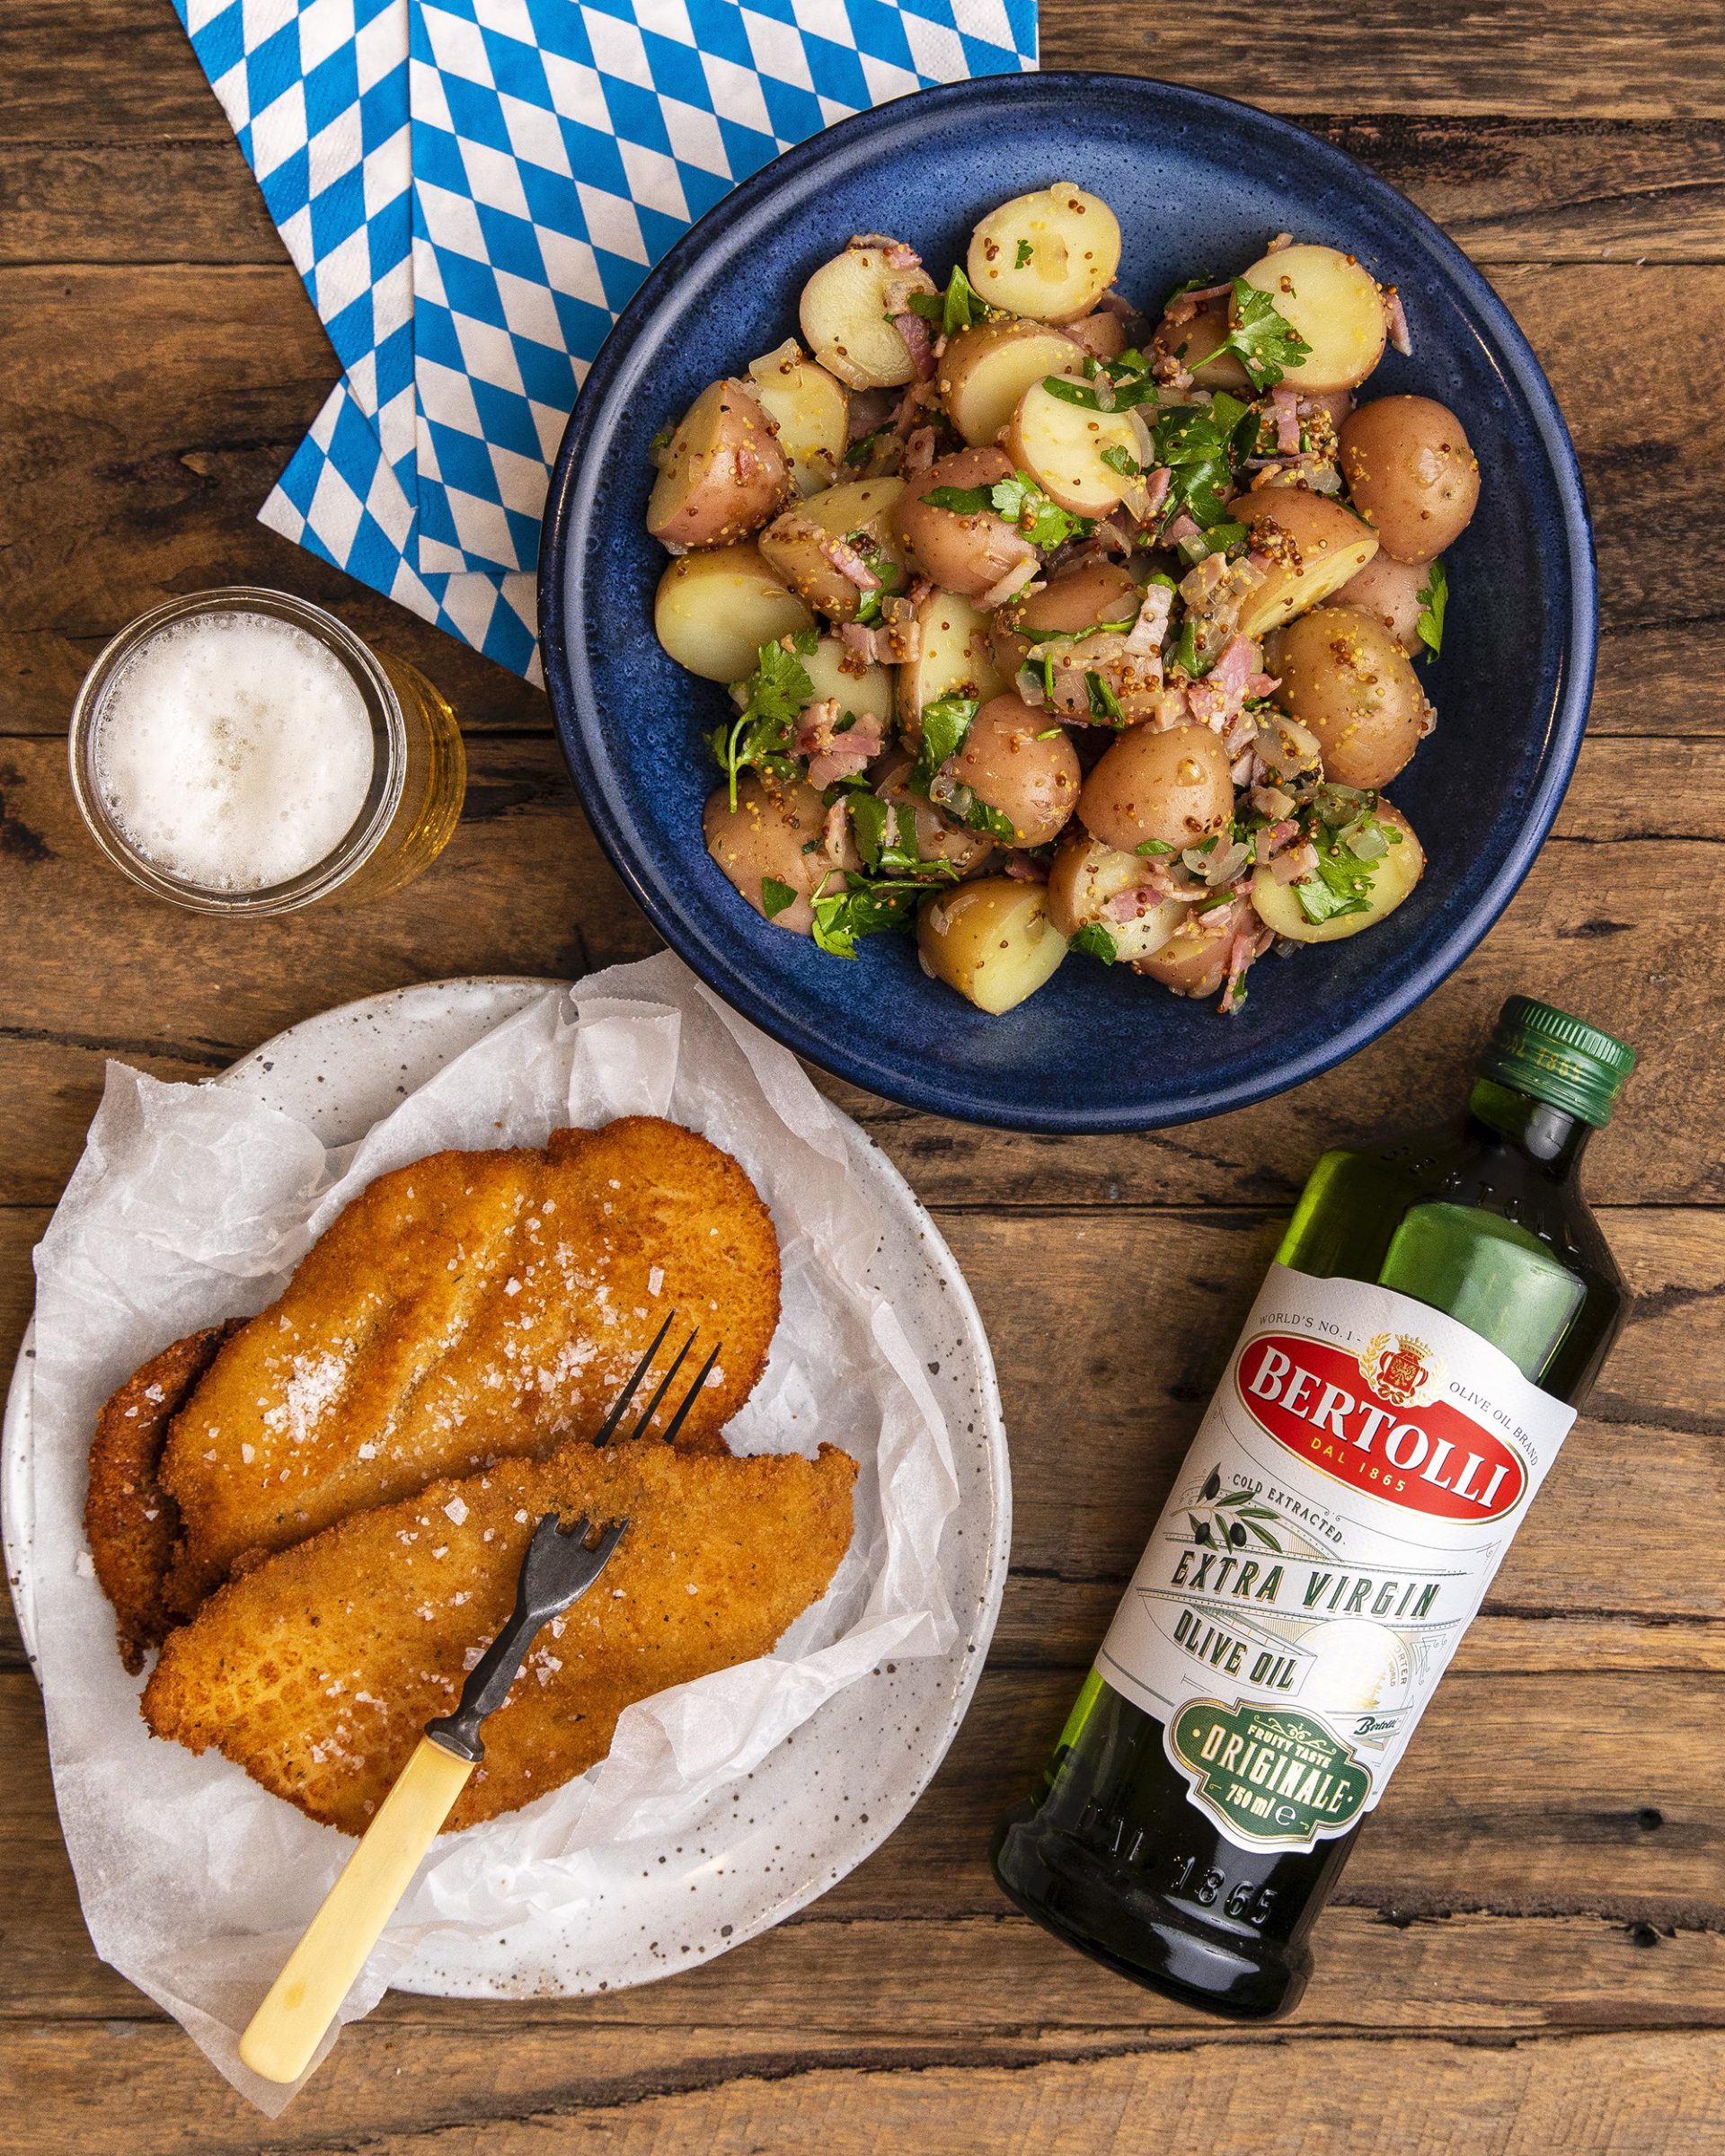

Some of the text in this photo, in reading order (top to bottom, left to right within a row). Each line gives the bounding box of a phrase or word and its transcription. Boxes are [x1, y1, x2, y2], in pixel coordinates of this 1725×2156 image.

[1260, 1313, 1314, 1328] WORLD'S
[1248, 1346, 1510, 1509] BERTOLLI
[1449, 1382, 1538, 1466] OLIVE OIL BRAND
[1311, 1437, 1406, 1492] DAL 1865
[1233, 1473, 1342, 1543] COLD EXTRACTED
[1171, 1551, 1442, 1620] EXTRA VIRGIN
[1173, 1609, 1249, 1677] OLIVE
[1250, 1651, 1298, 1692] OIL
[1200, 1724, 1350, 1814] ORIGINALE
[1247, 1724, 1332, 1769] FRUITY TASTE
[1171, 1855, 1278, 1925] 1865
